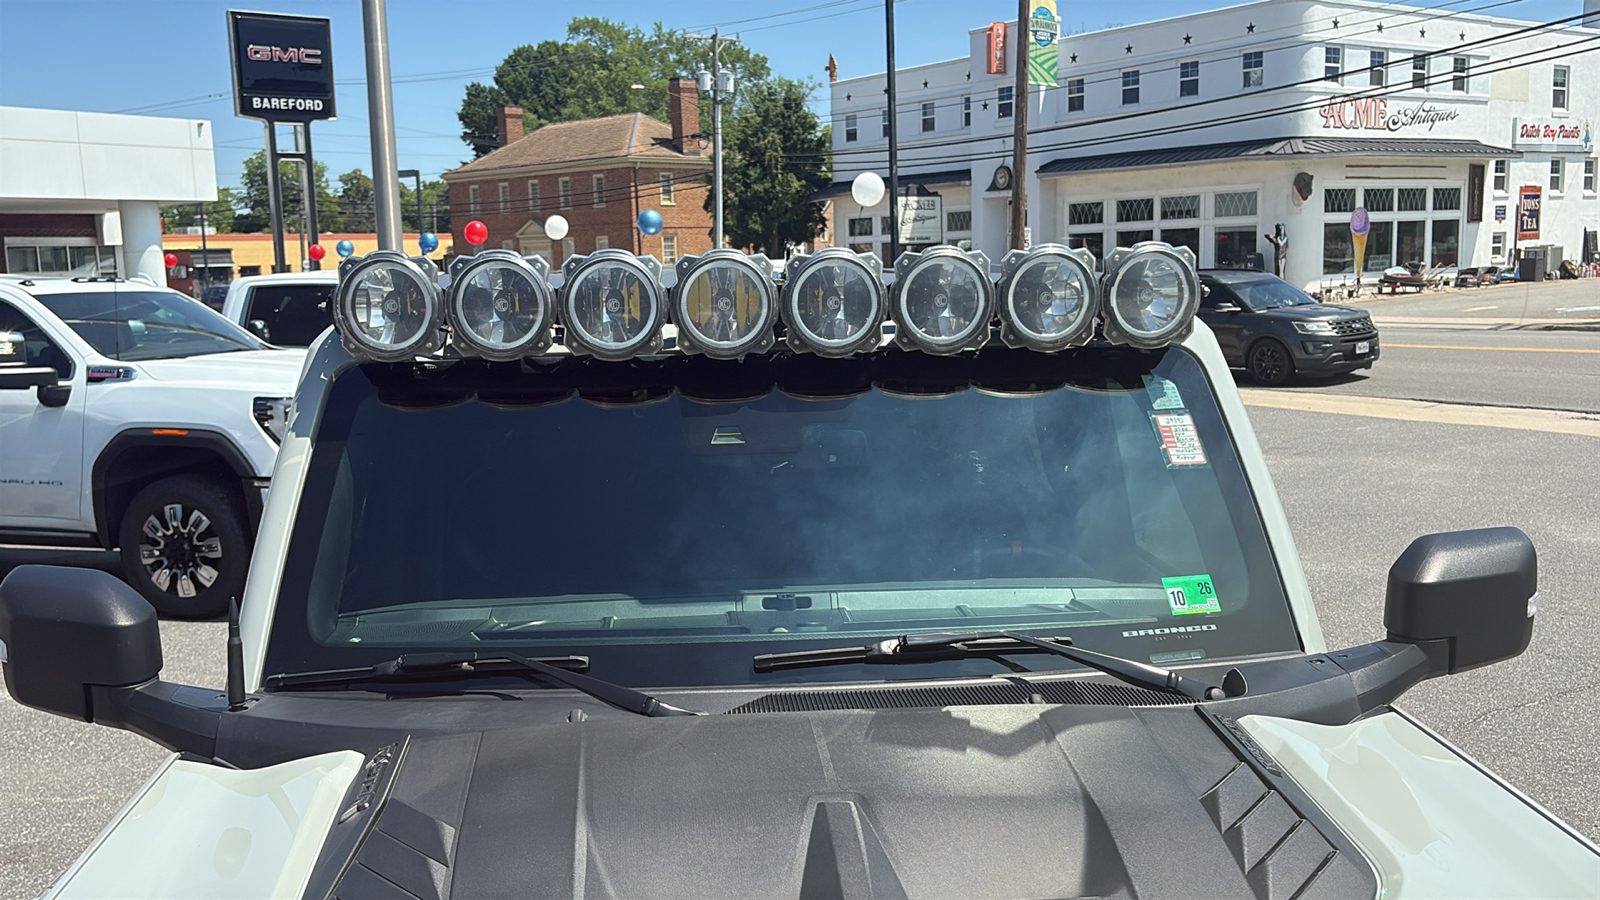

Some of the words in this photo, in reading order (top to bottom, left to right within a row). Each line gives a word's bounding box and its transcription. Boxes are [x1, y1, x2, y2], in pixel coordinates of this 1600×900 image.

[247, 44, 322, 64] GMC
[252, 97, 323, 111] BAREFORD
[1320, 96, 1387, 130] ACME
[1520, 124, 1541, 138] Dutch
[1543, 124, 1557, 142] Boy
[1557, 124, 1580, 139] Paints
[1522, 216, 1537, 230] TEA
[1197, 582, 1212, 595] 26
[1170, 590, 1186, 606] 10
[1122, 624, 1217, 637] BRONCO
